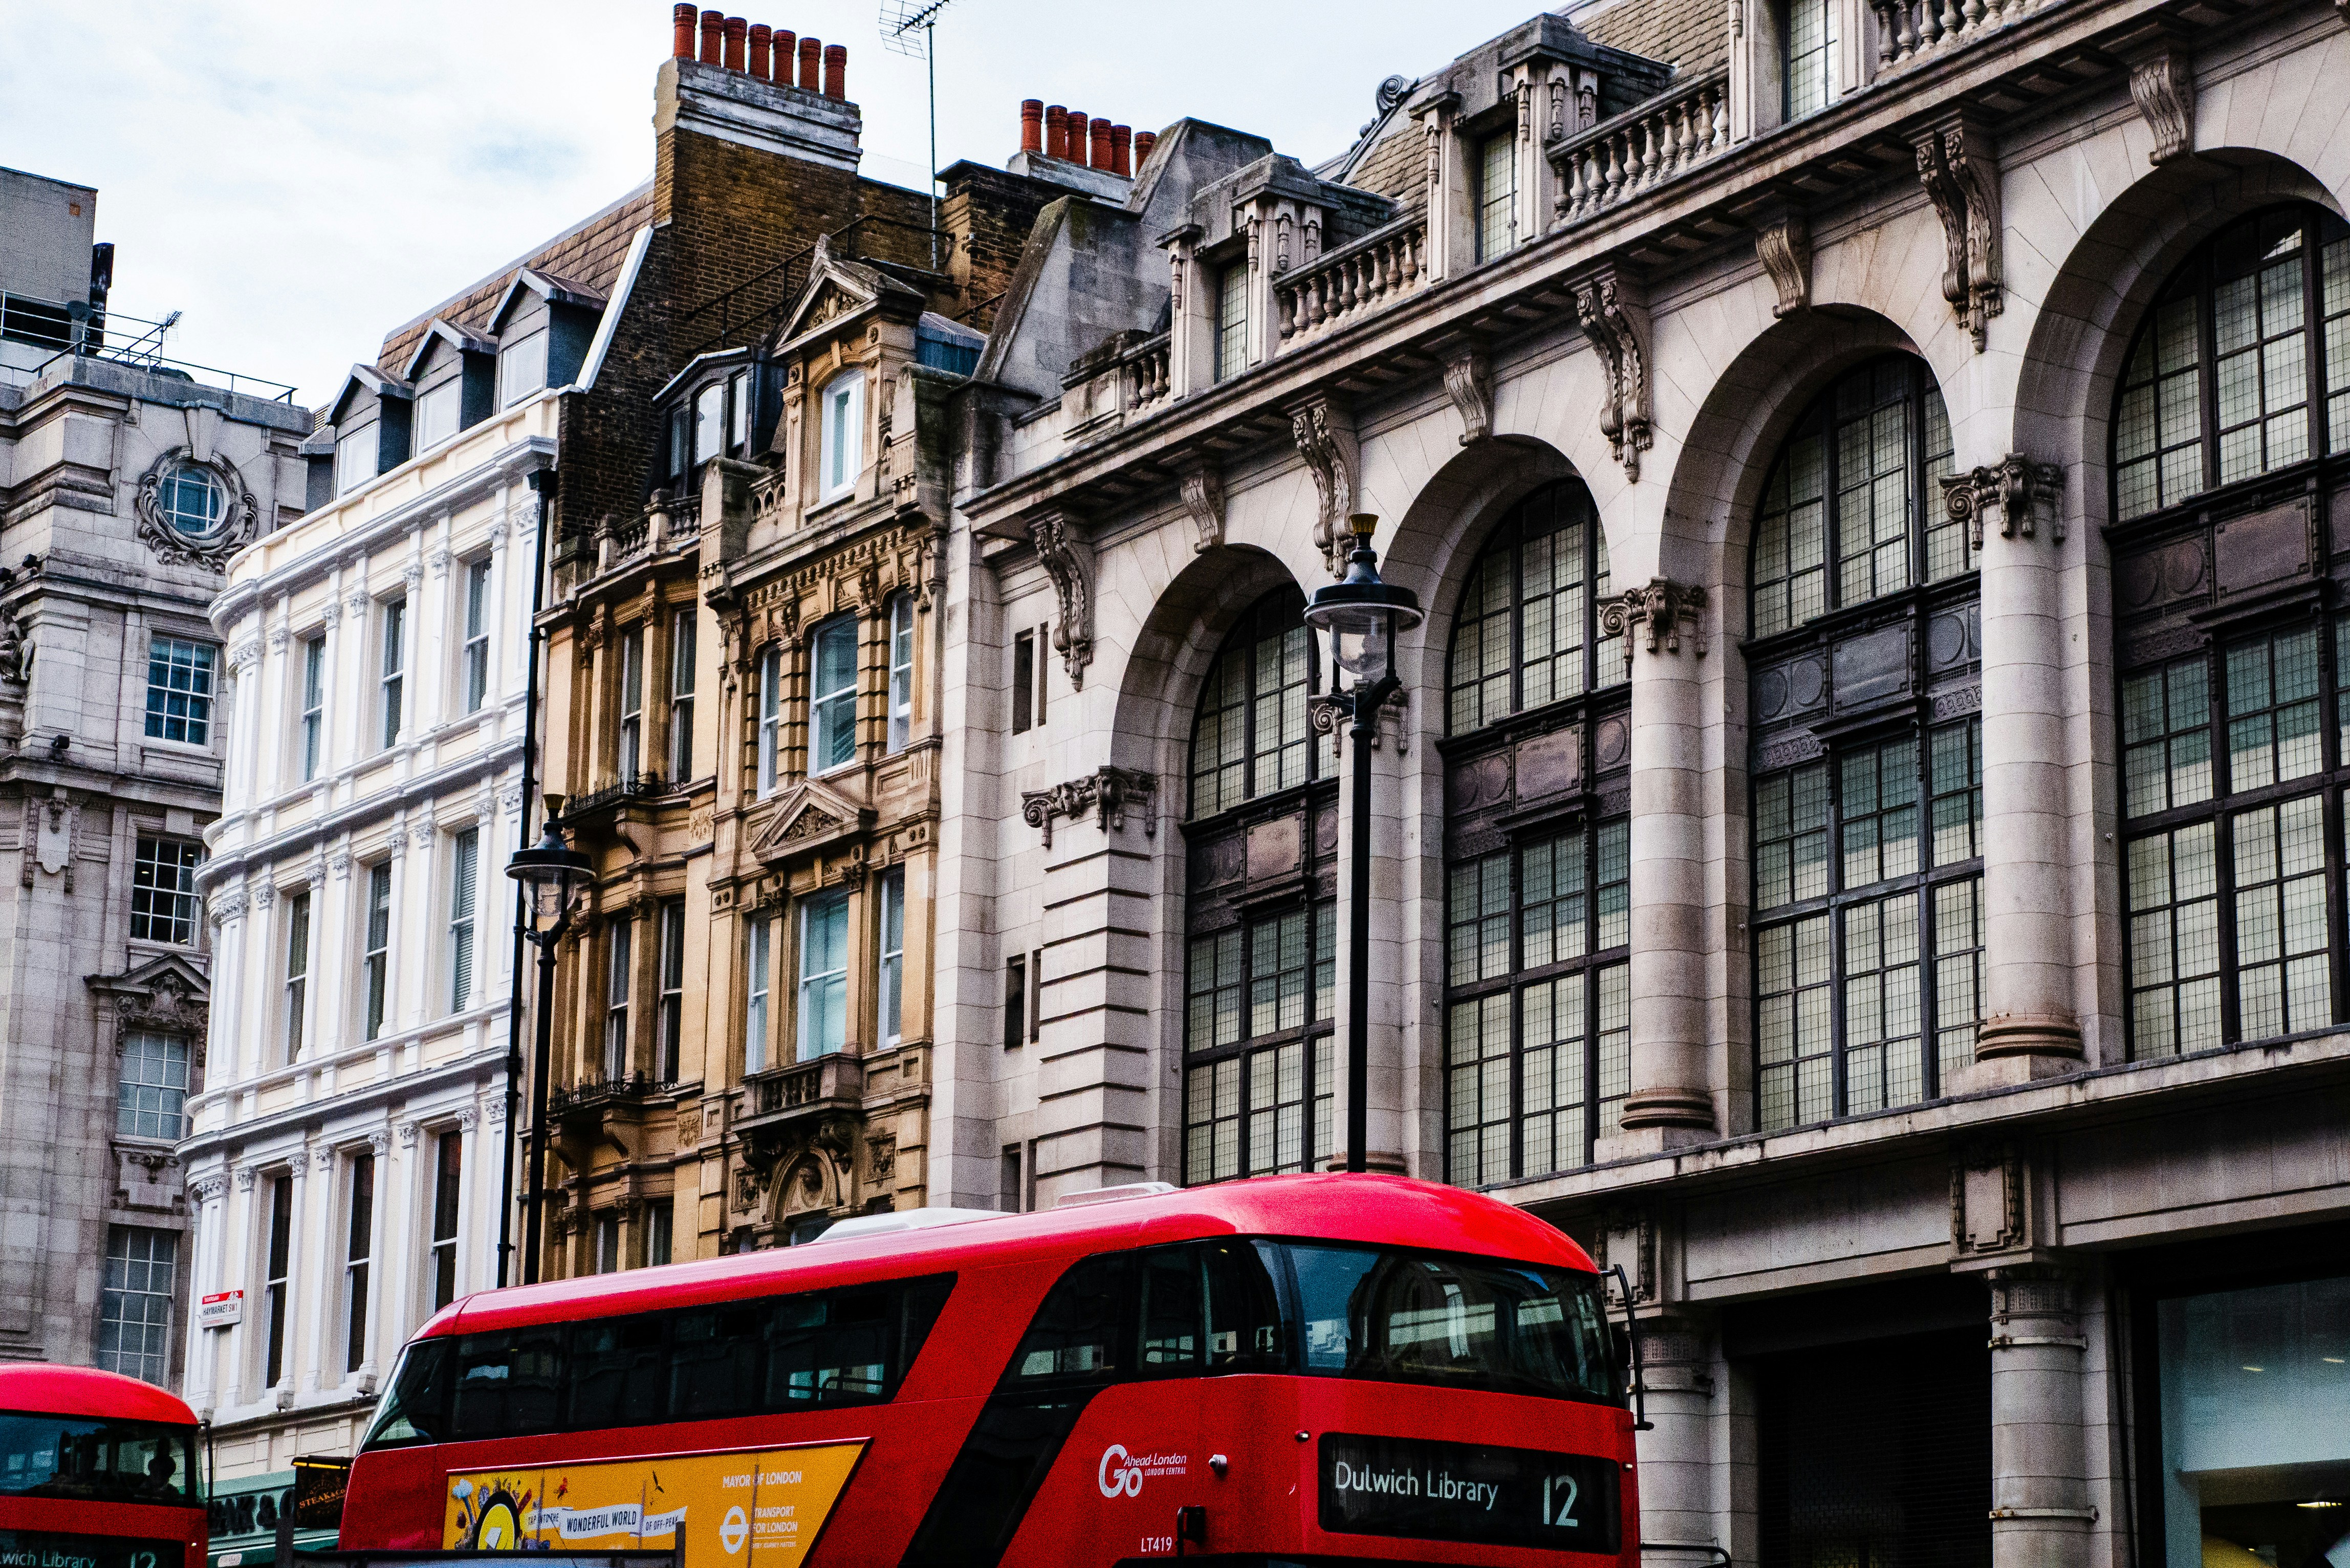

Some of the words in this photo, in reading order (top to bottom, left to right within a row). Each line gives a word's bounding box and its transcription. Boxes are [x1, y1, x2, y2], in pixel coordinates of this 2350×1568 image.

[203, 1304, 228, 1316] HAYMARKET
[228, 1302, 237, 1312] SW1
[1124, 1453, 1187, 1467] Ahead-London
[1166, 1467, 1186, 1475] CENTRAL
[723, 1474, 751, 1488] MAYOR
[766, 1471, 802, 1485] LONDON
[1335, 1461, 1419, 1496] Dulwich
[1427, 1470, 1498, 1511] Library
[1543, 1475, 1578, 1527] 12
[754, 1506, 795, 1518] TRANSPORT
[528, 1515, 536, 1526] TAP
[567, 1513, 609, 1532] WONDERFUL
[612, 1511, 637, 1527] WORLD
[645, 1520, 652, 1531] OF
[767, 1521, 798, 1533] LONDON
[1141, 1536, 1172, 1552] LT419
[0, 1550, 36, 1567] wich
[42, 1550, 97, 1568] Library
